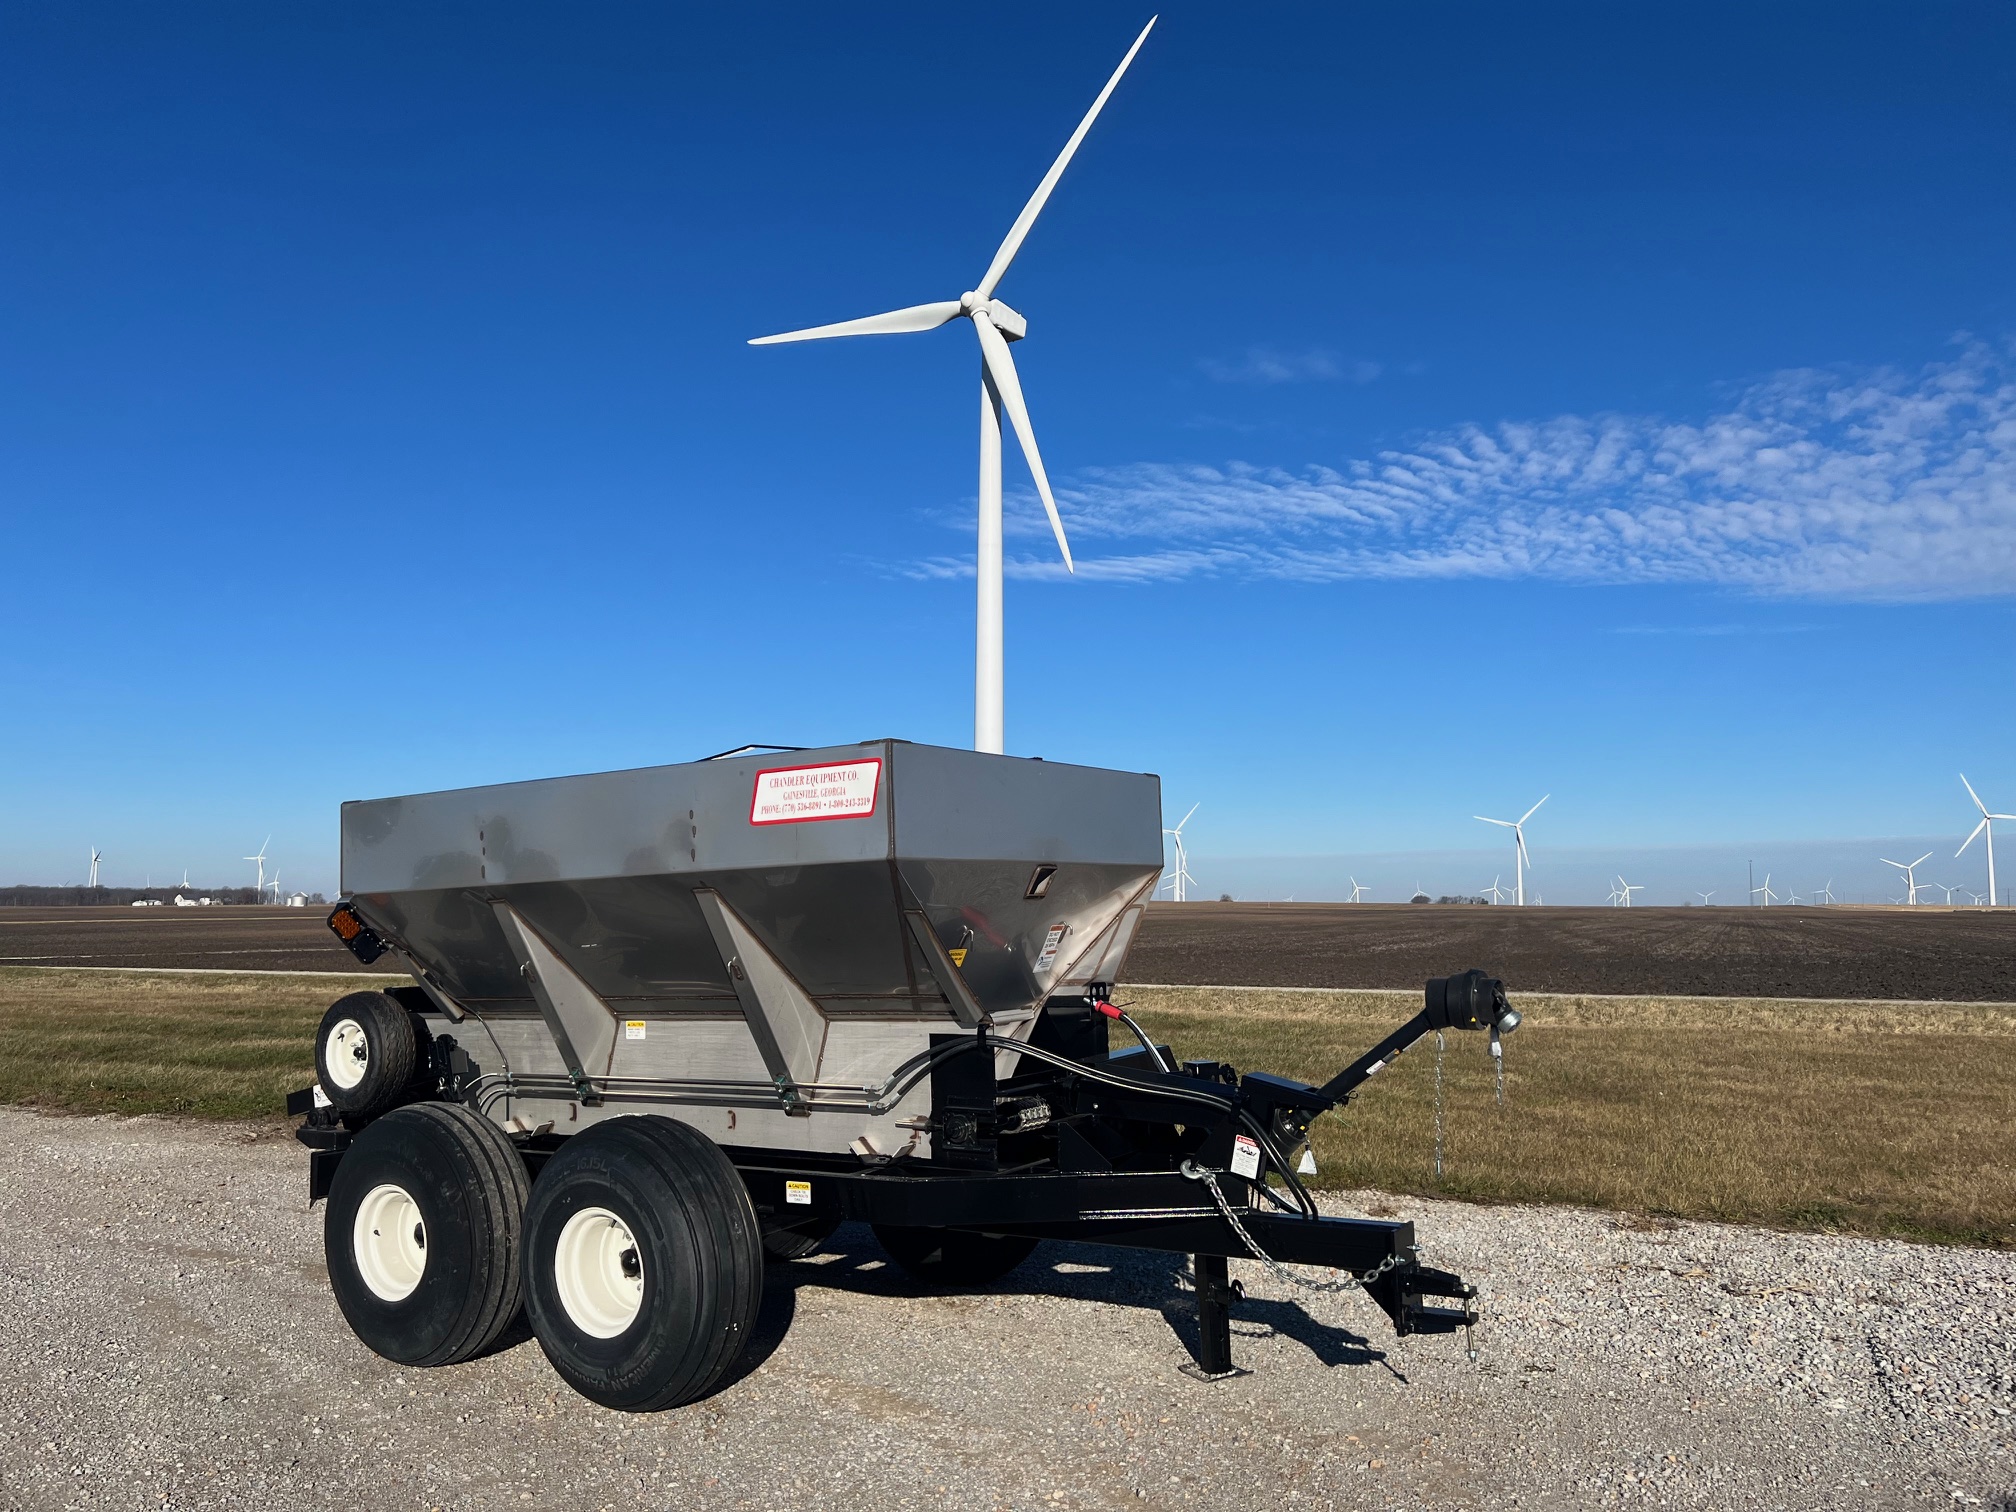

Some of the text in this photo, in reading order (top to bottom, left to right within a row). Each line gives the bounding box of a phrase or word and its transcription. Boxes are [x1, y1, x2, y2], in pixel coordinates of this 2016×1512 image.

[769, 770, 860, 788] CHANDLER EQUIPMENT CO.
[783, 787, 846, 800] GAINESVILLE, GEORGIA
[761, 805, 781, 815] PHONE:
